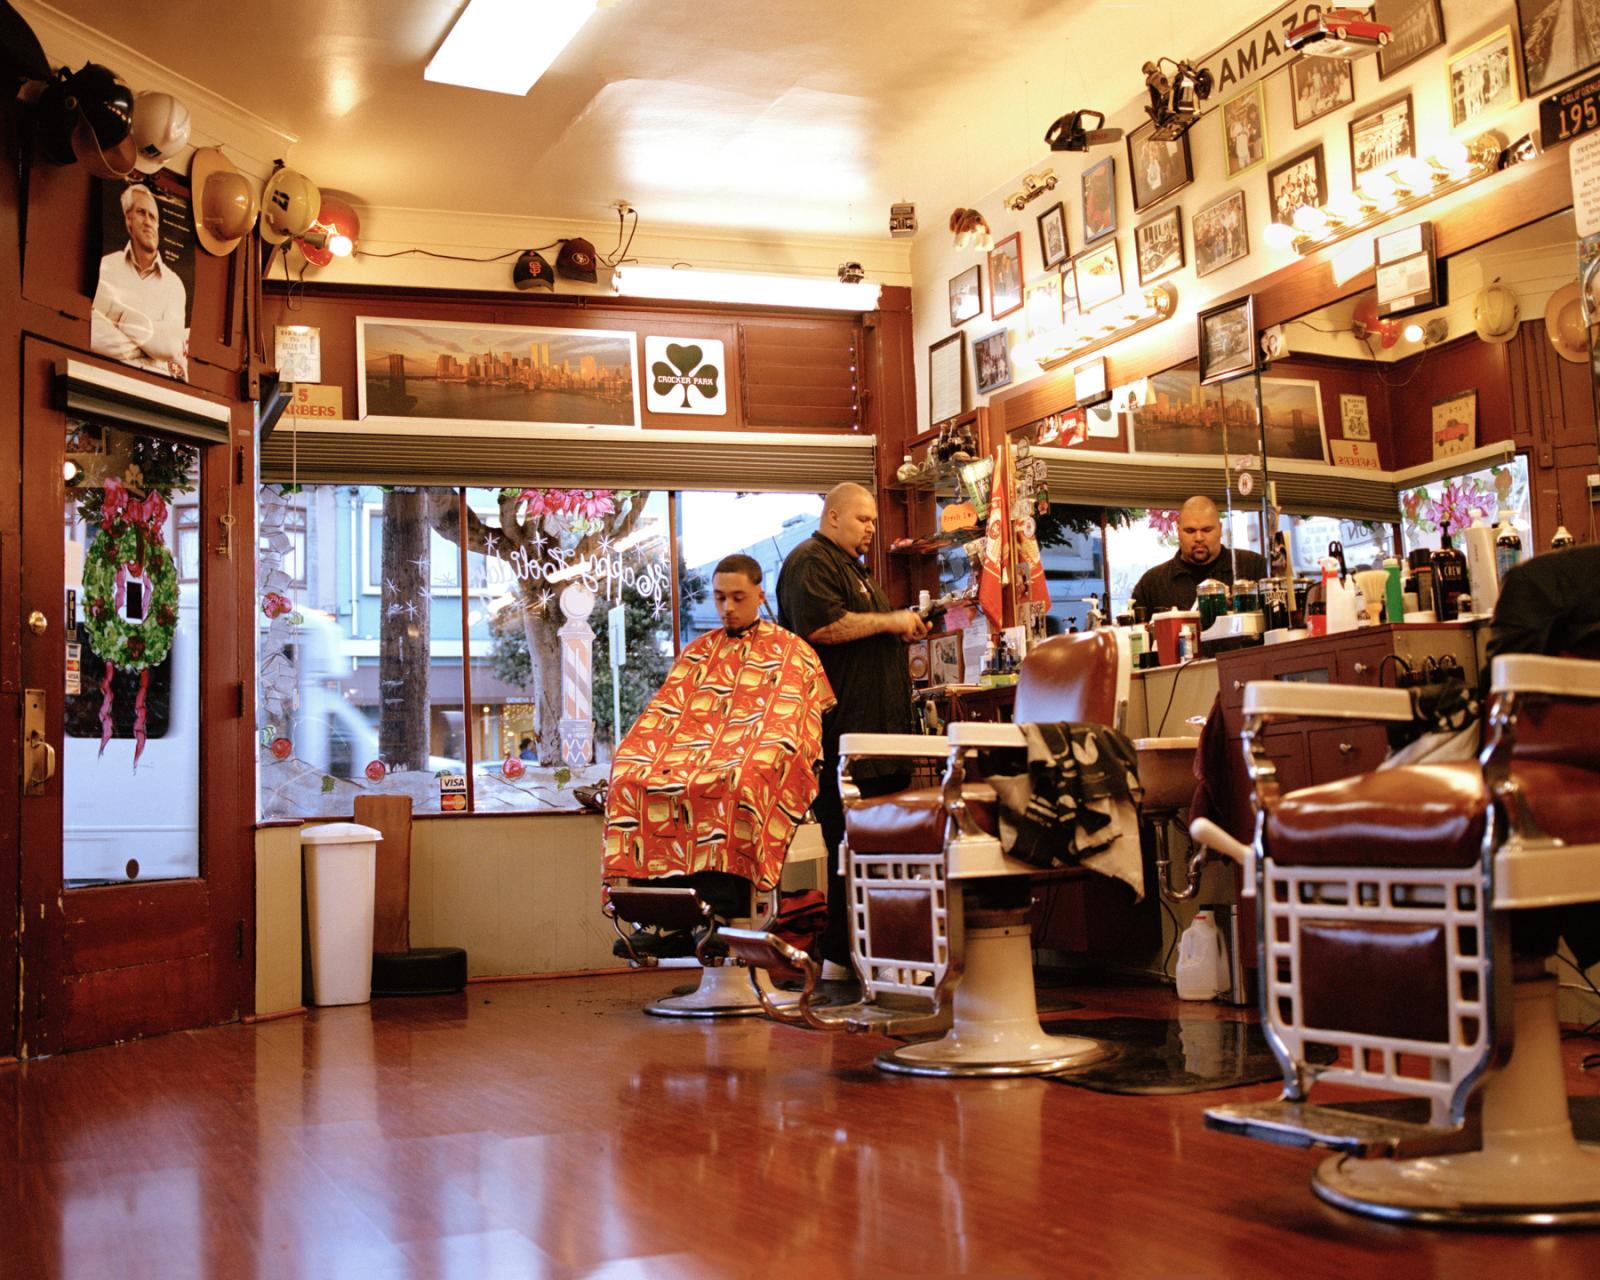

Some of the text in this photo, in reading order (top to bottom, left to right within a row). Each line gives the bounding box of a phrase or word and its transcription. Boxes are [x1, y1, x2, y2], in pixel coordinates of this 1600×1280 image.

[1218, 4, 1333, 93] AMAZO
[1559, 97, 1600, 138] 195
[657, 375, 713, 386] CROCKER PARK
[298, 388, 308, 402] 5
[285, 403, 336, 417] ARBERS
[1443, 565, 1461, 577] CREW
[444, 778, 465, 788] VISA
